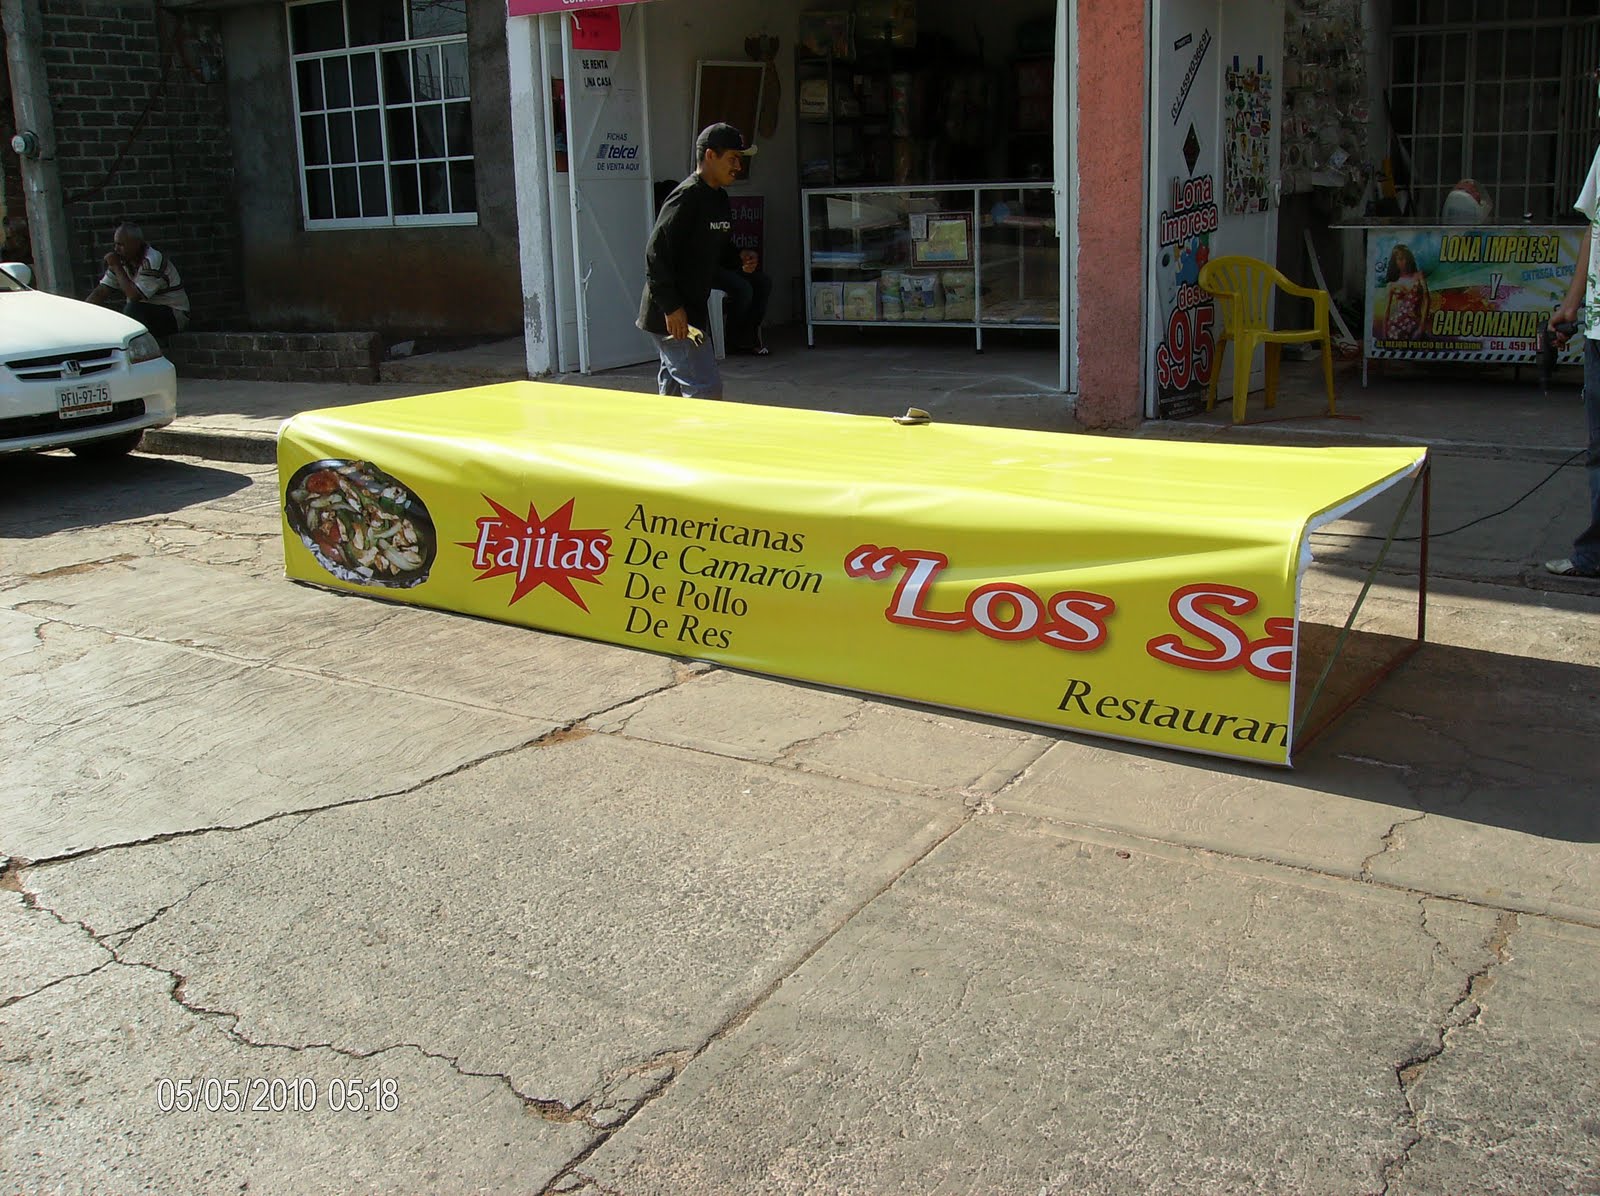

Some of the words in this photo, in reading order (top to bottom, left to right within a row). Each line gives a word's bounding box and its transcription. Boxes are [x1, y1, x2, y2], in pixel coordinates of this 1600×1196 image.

[582, 59, 590, 70] SE
[590, 59, 609, 70] RENTA
[584, 77, 596, 88] UNA
[596, 76, 612, 88] CASA
[606, 132, 628, 141] FICHAS
[608, 144, 639, 159] telcel
[597, 162, 606, 171] DE
[606, 162, 625, 171] VENTA
[1173, 175, 1213, 212] Lona
[1439, 236, 1482, 262] LONA
[1483, 236, 1559, 264] IMPRESA
[1490, 273, 1502, 300] Y
[1156, 303, 1215, 390] $95
[1408, 341, 1434, 349] PRECIO
[1508, 341, 1526, 351] 459
[624, 504, 806, 553] Americanas
[473, 518, 612, 583] Fajitas
[624, 538, 669, 570] De
[678, 545, 824, 593] Camarón
[624, 571, 667, 604] De
[676, 580, 749, 617] Pollo
[625, 606, 669, 638] De
[676, 614, 733, 649] Res
